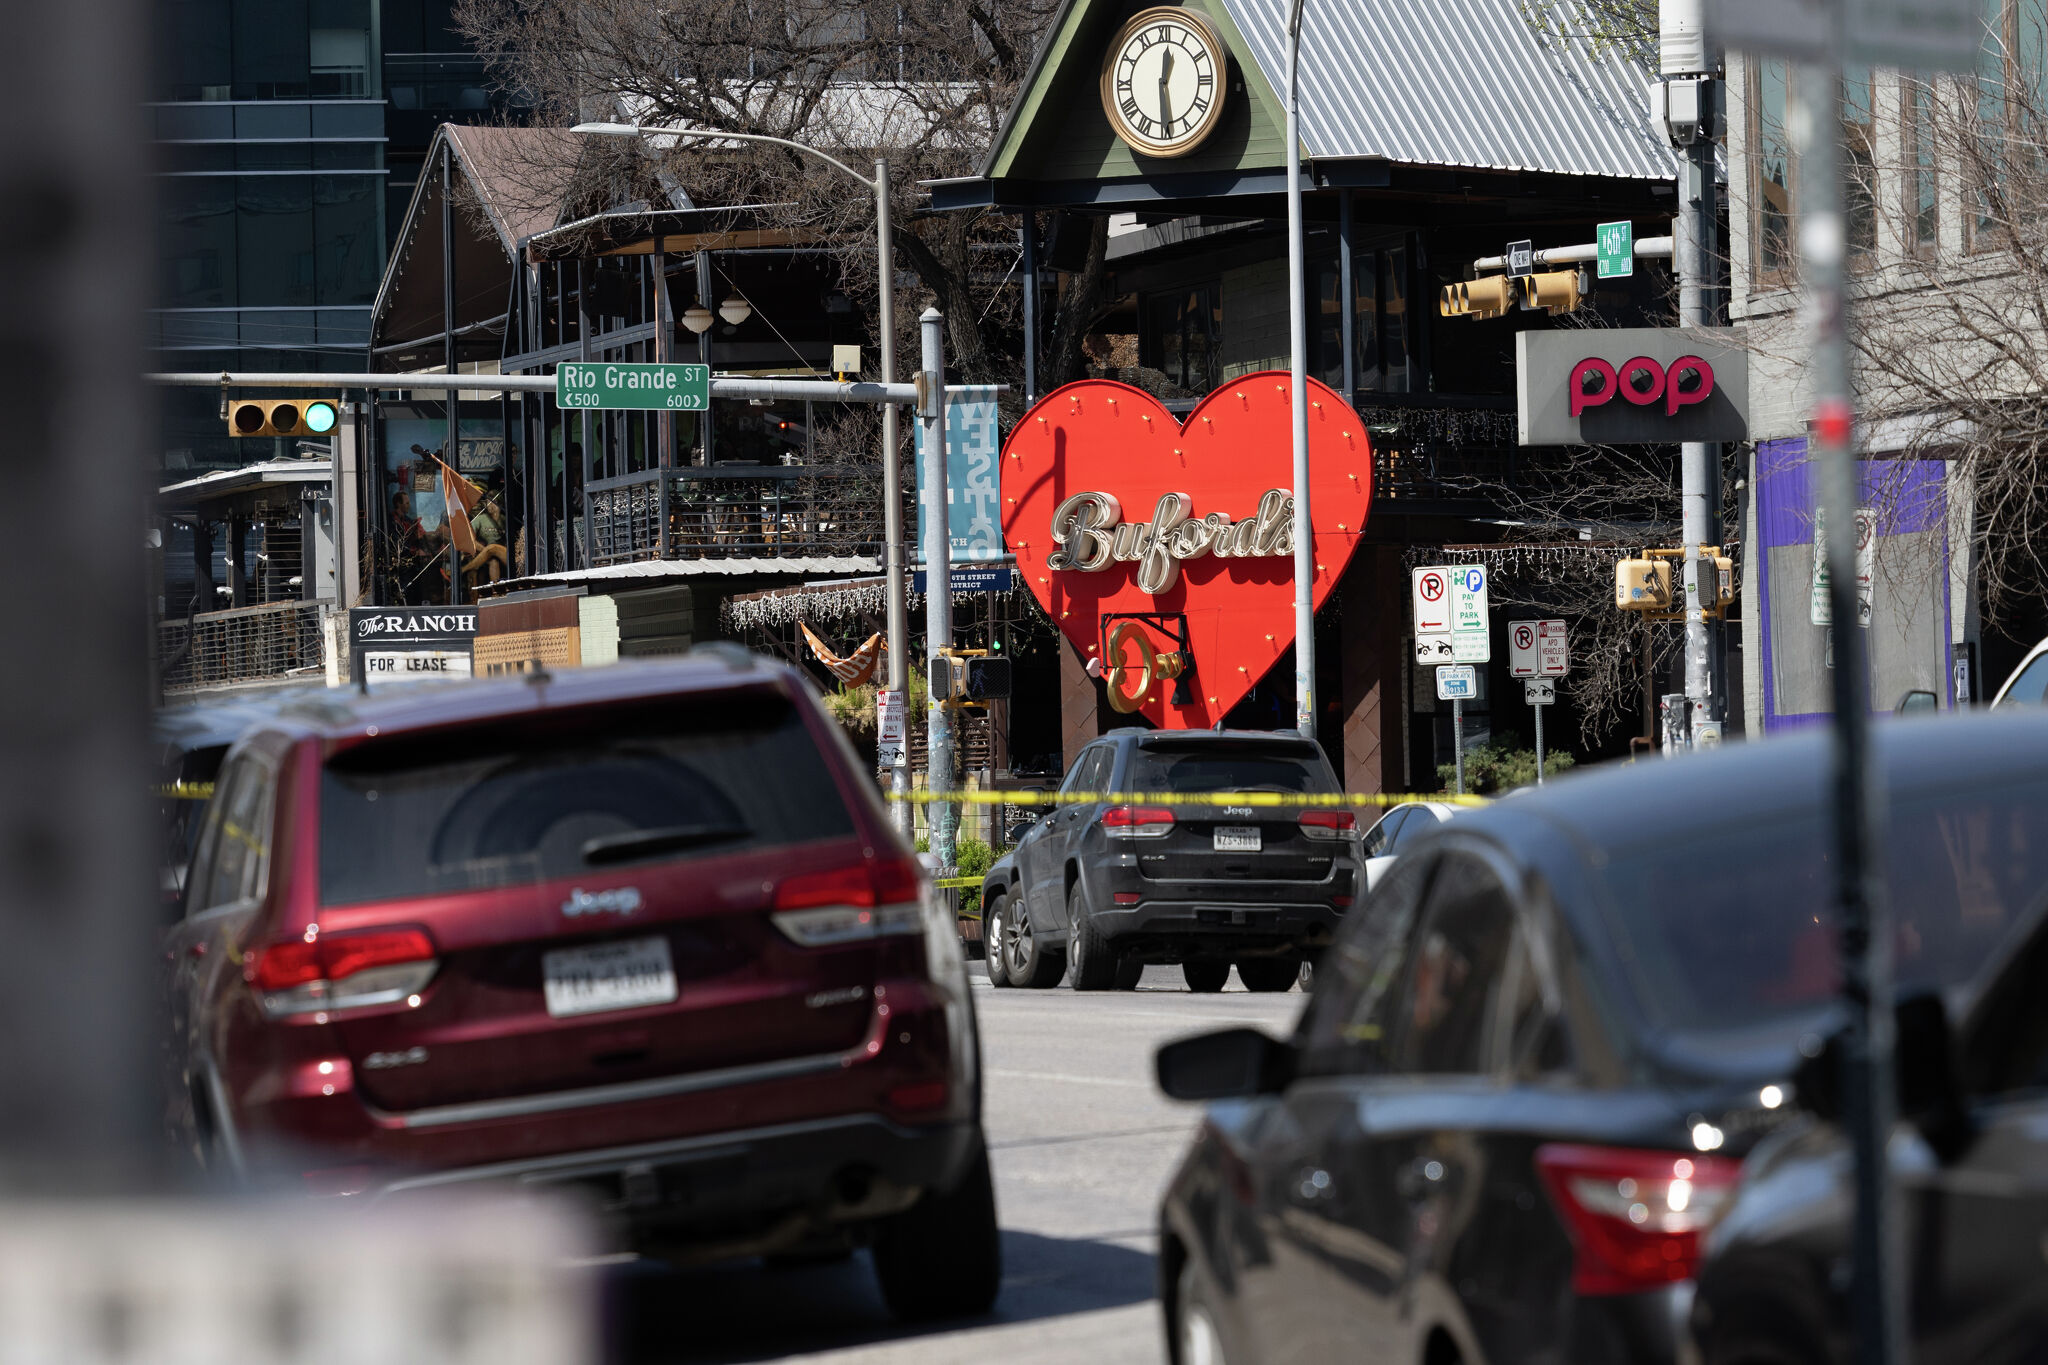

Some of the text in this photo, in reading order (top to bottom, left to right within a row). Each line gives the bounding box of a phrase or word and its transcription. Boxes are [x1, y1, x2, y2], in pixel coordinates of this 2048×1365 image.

[1158, 25, 1171, 42] XII
[1199, 75, 1212, 85] III
[1607, 227, 1621, 256] 6th
[565, 366, 701, 390] Rio Grande ST
[574, 393, 692, 408] 500 600
[967, 573, 996, 581] STREET
[1462, 593, 1475, 601] PAY
[1464, 602, 1473, 610] TO
[1459, 611, 1479, 619] PARK
[358, 614, 477, 637] The RANCH
[1547, 625, 1566, 633] PARKING
[369, 657, 447, 672] FOR LEASE
[1223, 804, 1253, 817] Jeep
[562, 887, 642, 917] Jeep
